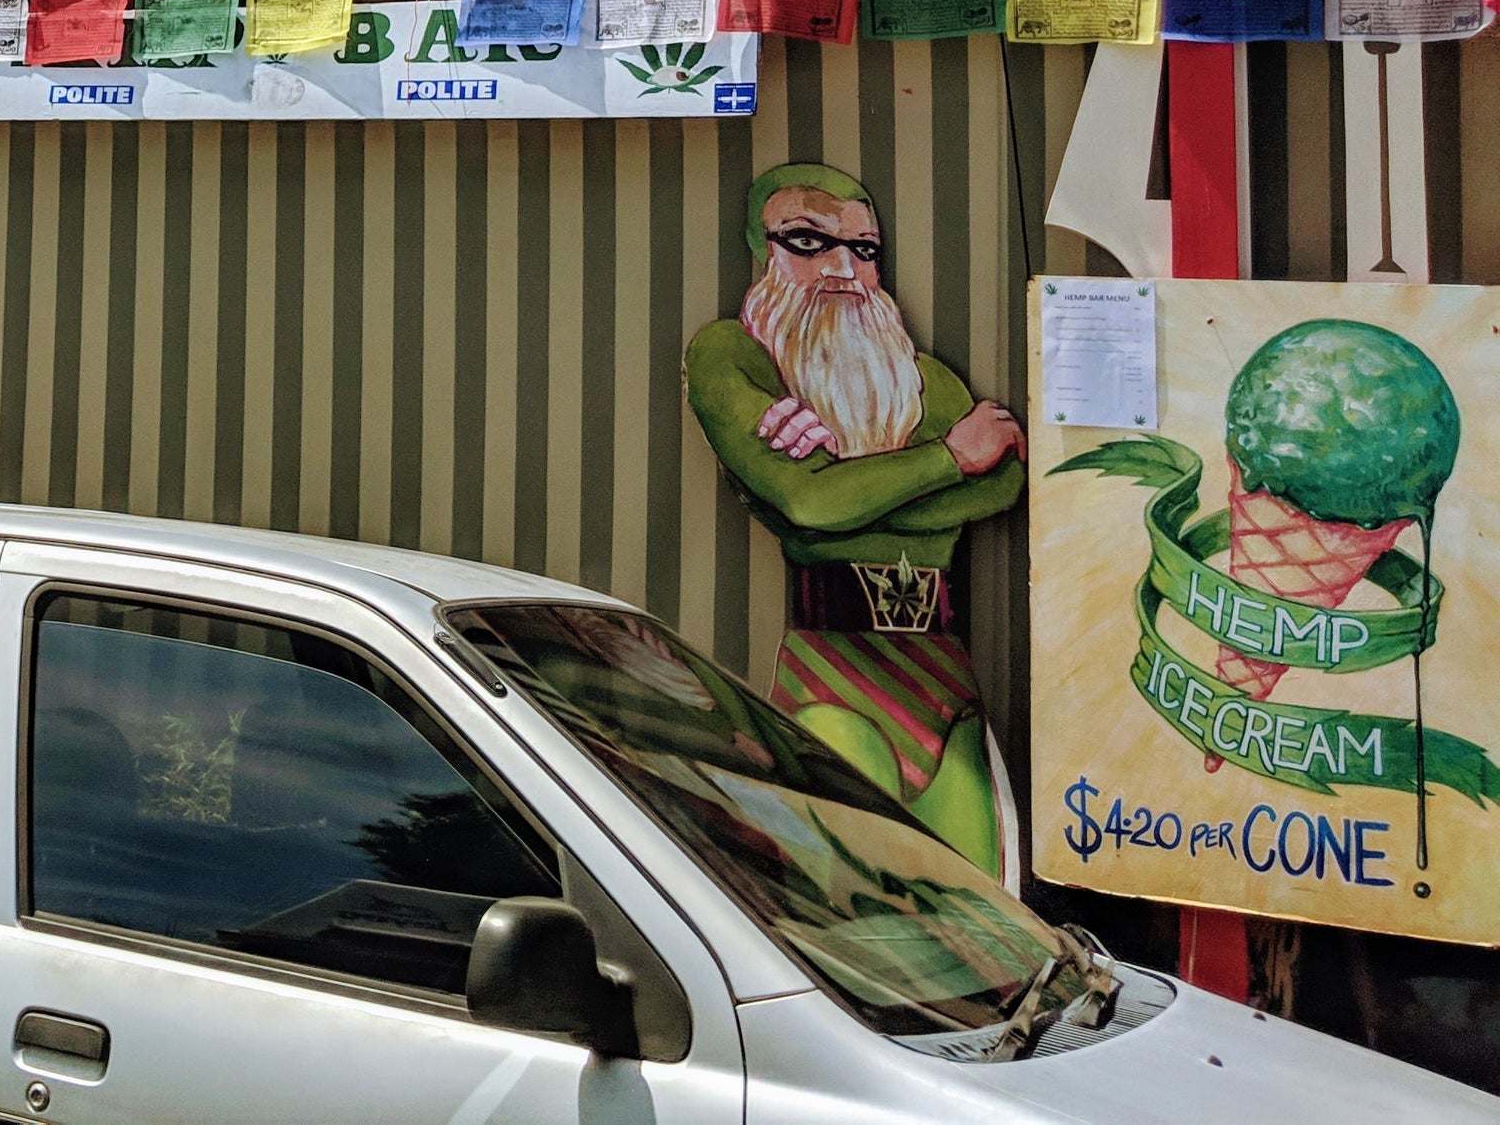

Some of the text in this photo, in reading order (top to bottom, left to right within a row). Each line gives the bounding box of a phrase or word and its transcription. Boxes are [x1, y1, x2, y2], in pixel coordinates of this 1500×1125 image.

[51, 86, 130, 103] POLITE
[400, 81, 494, 99] POLITE
[1106, 295, 1130, 303] MENU
[1185, 572, 1370, 663] HEMP
[1189, 822, 1238, 861] PER
